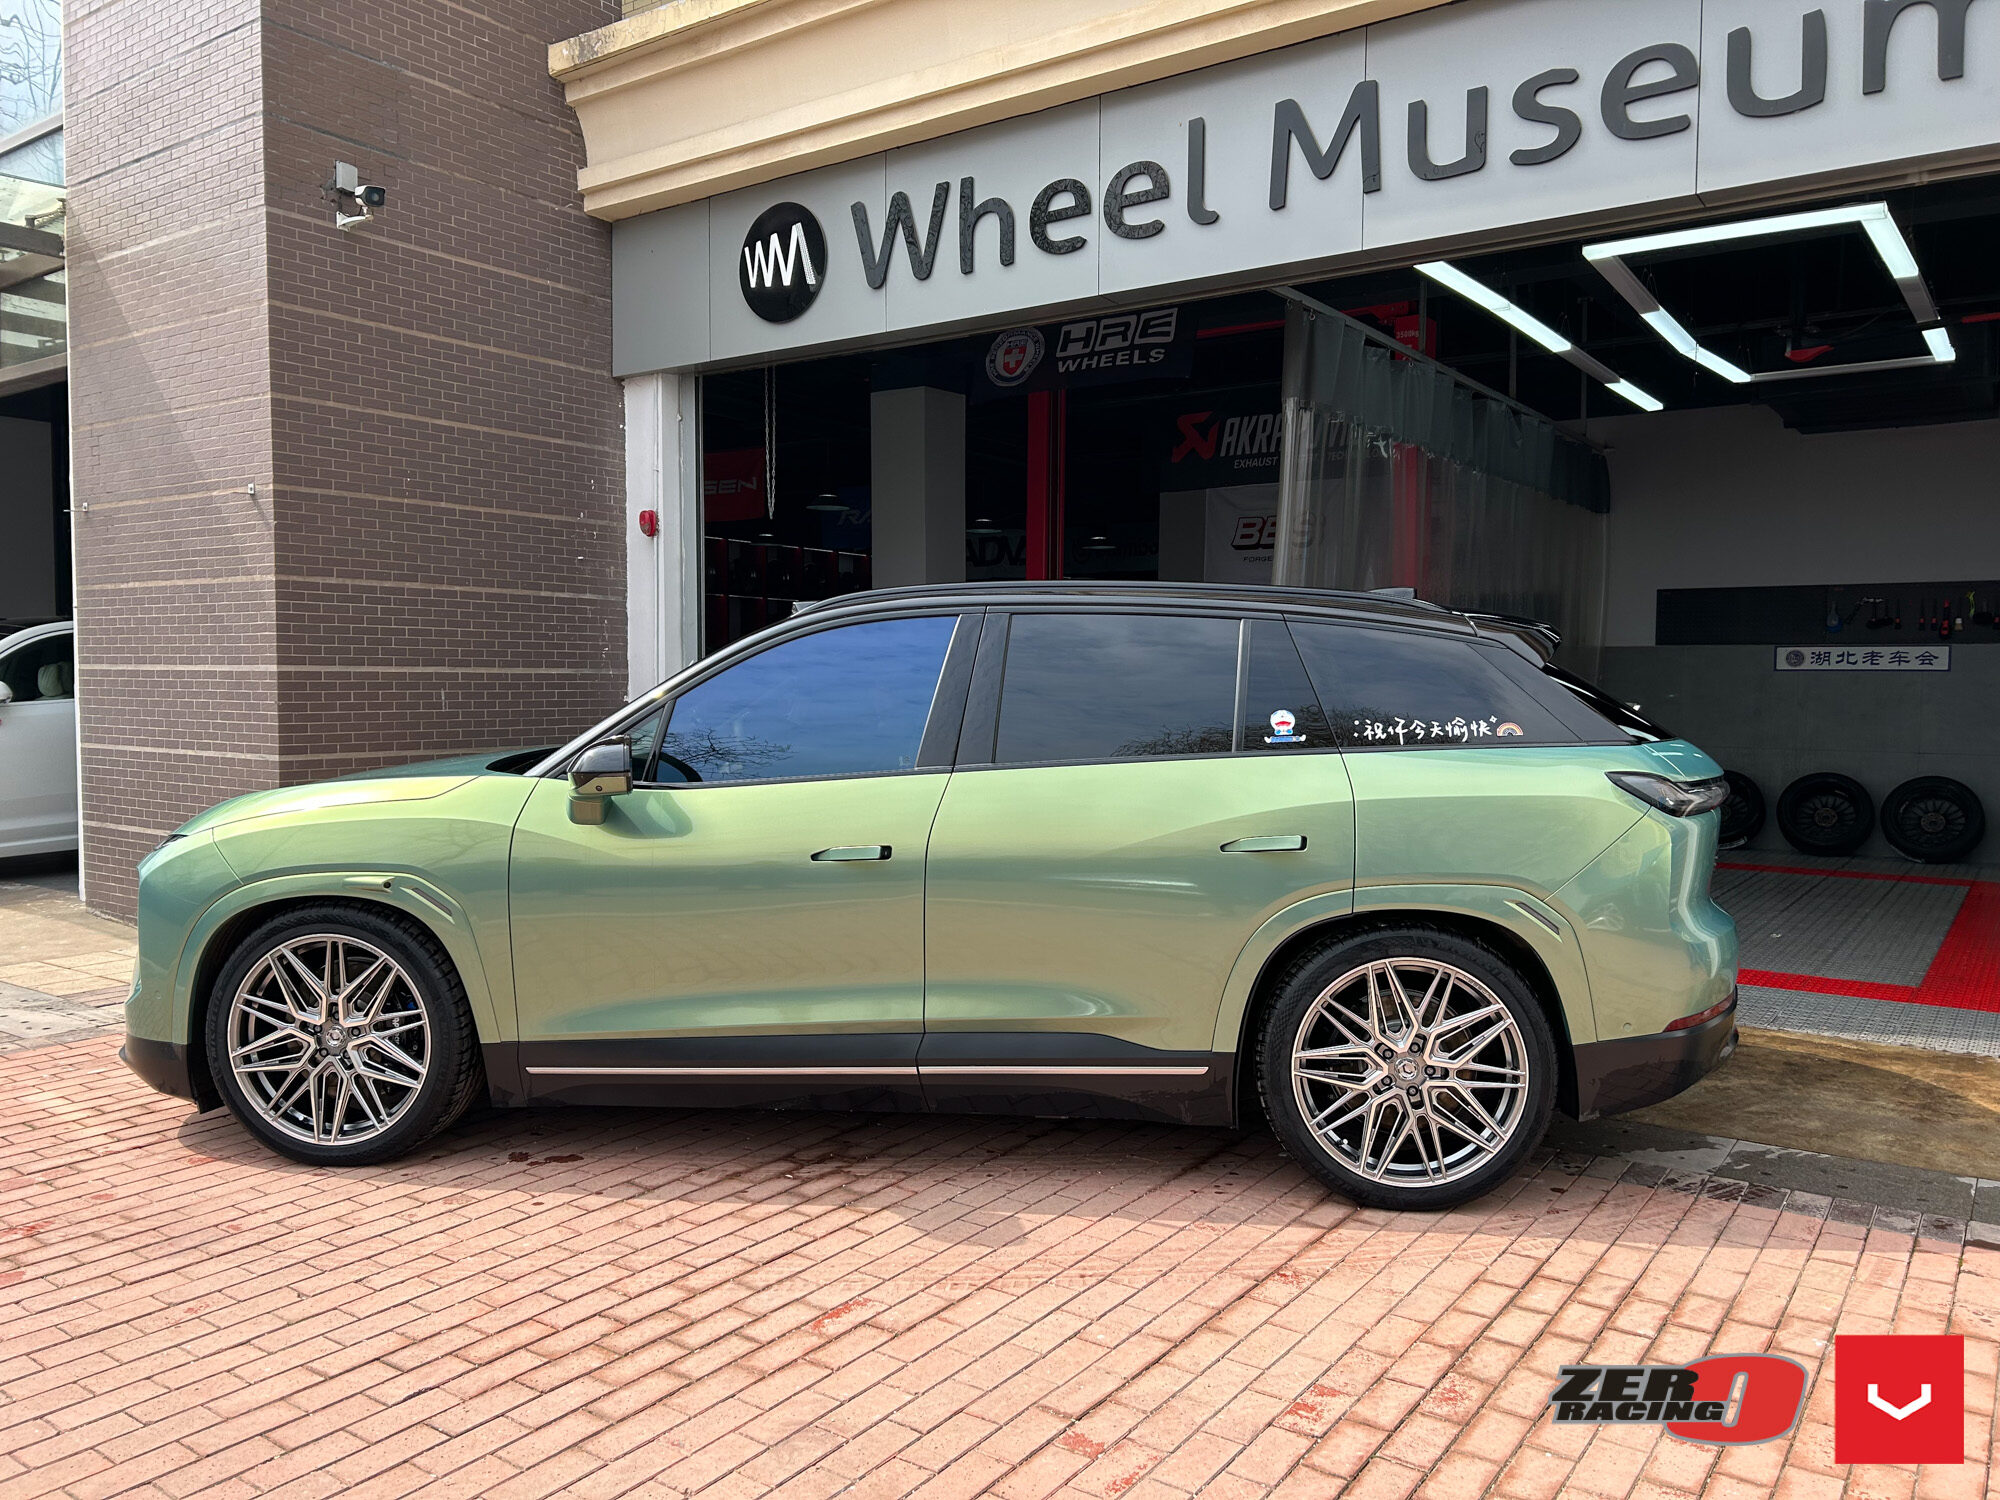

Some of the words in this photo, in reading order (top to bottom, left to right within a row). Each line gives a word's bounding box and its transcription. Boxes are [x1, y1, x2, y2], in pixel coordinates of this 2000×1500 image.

[850, 116, 1220, 289] Wheel
[1056, 307, 1178, 357] HRE
[1057, 348, 1166, 374] WHEELS
[1810, 650, 1939, 667] 湖北老车会
